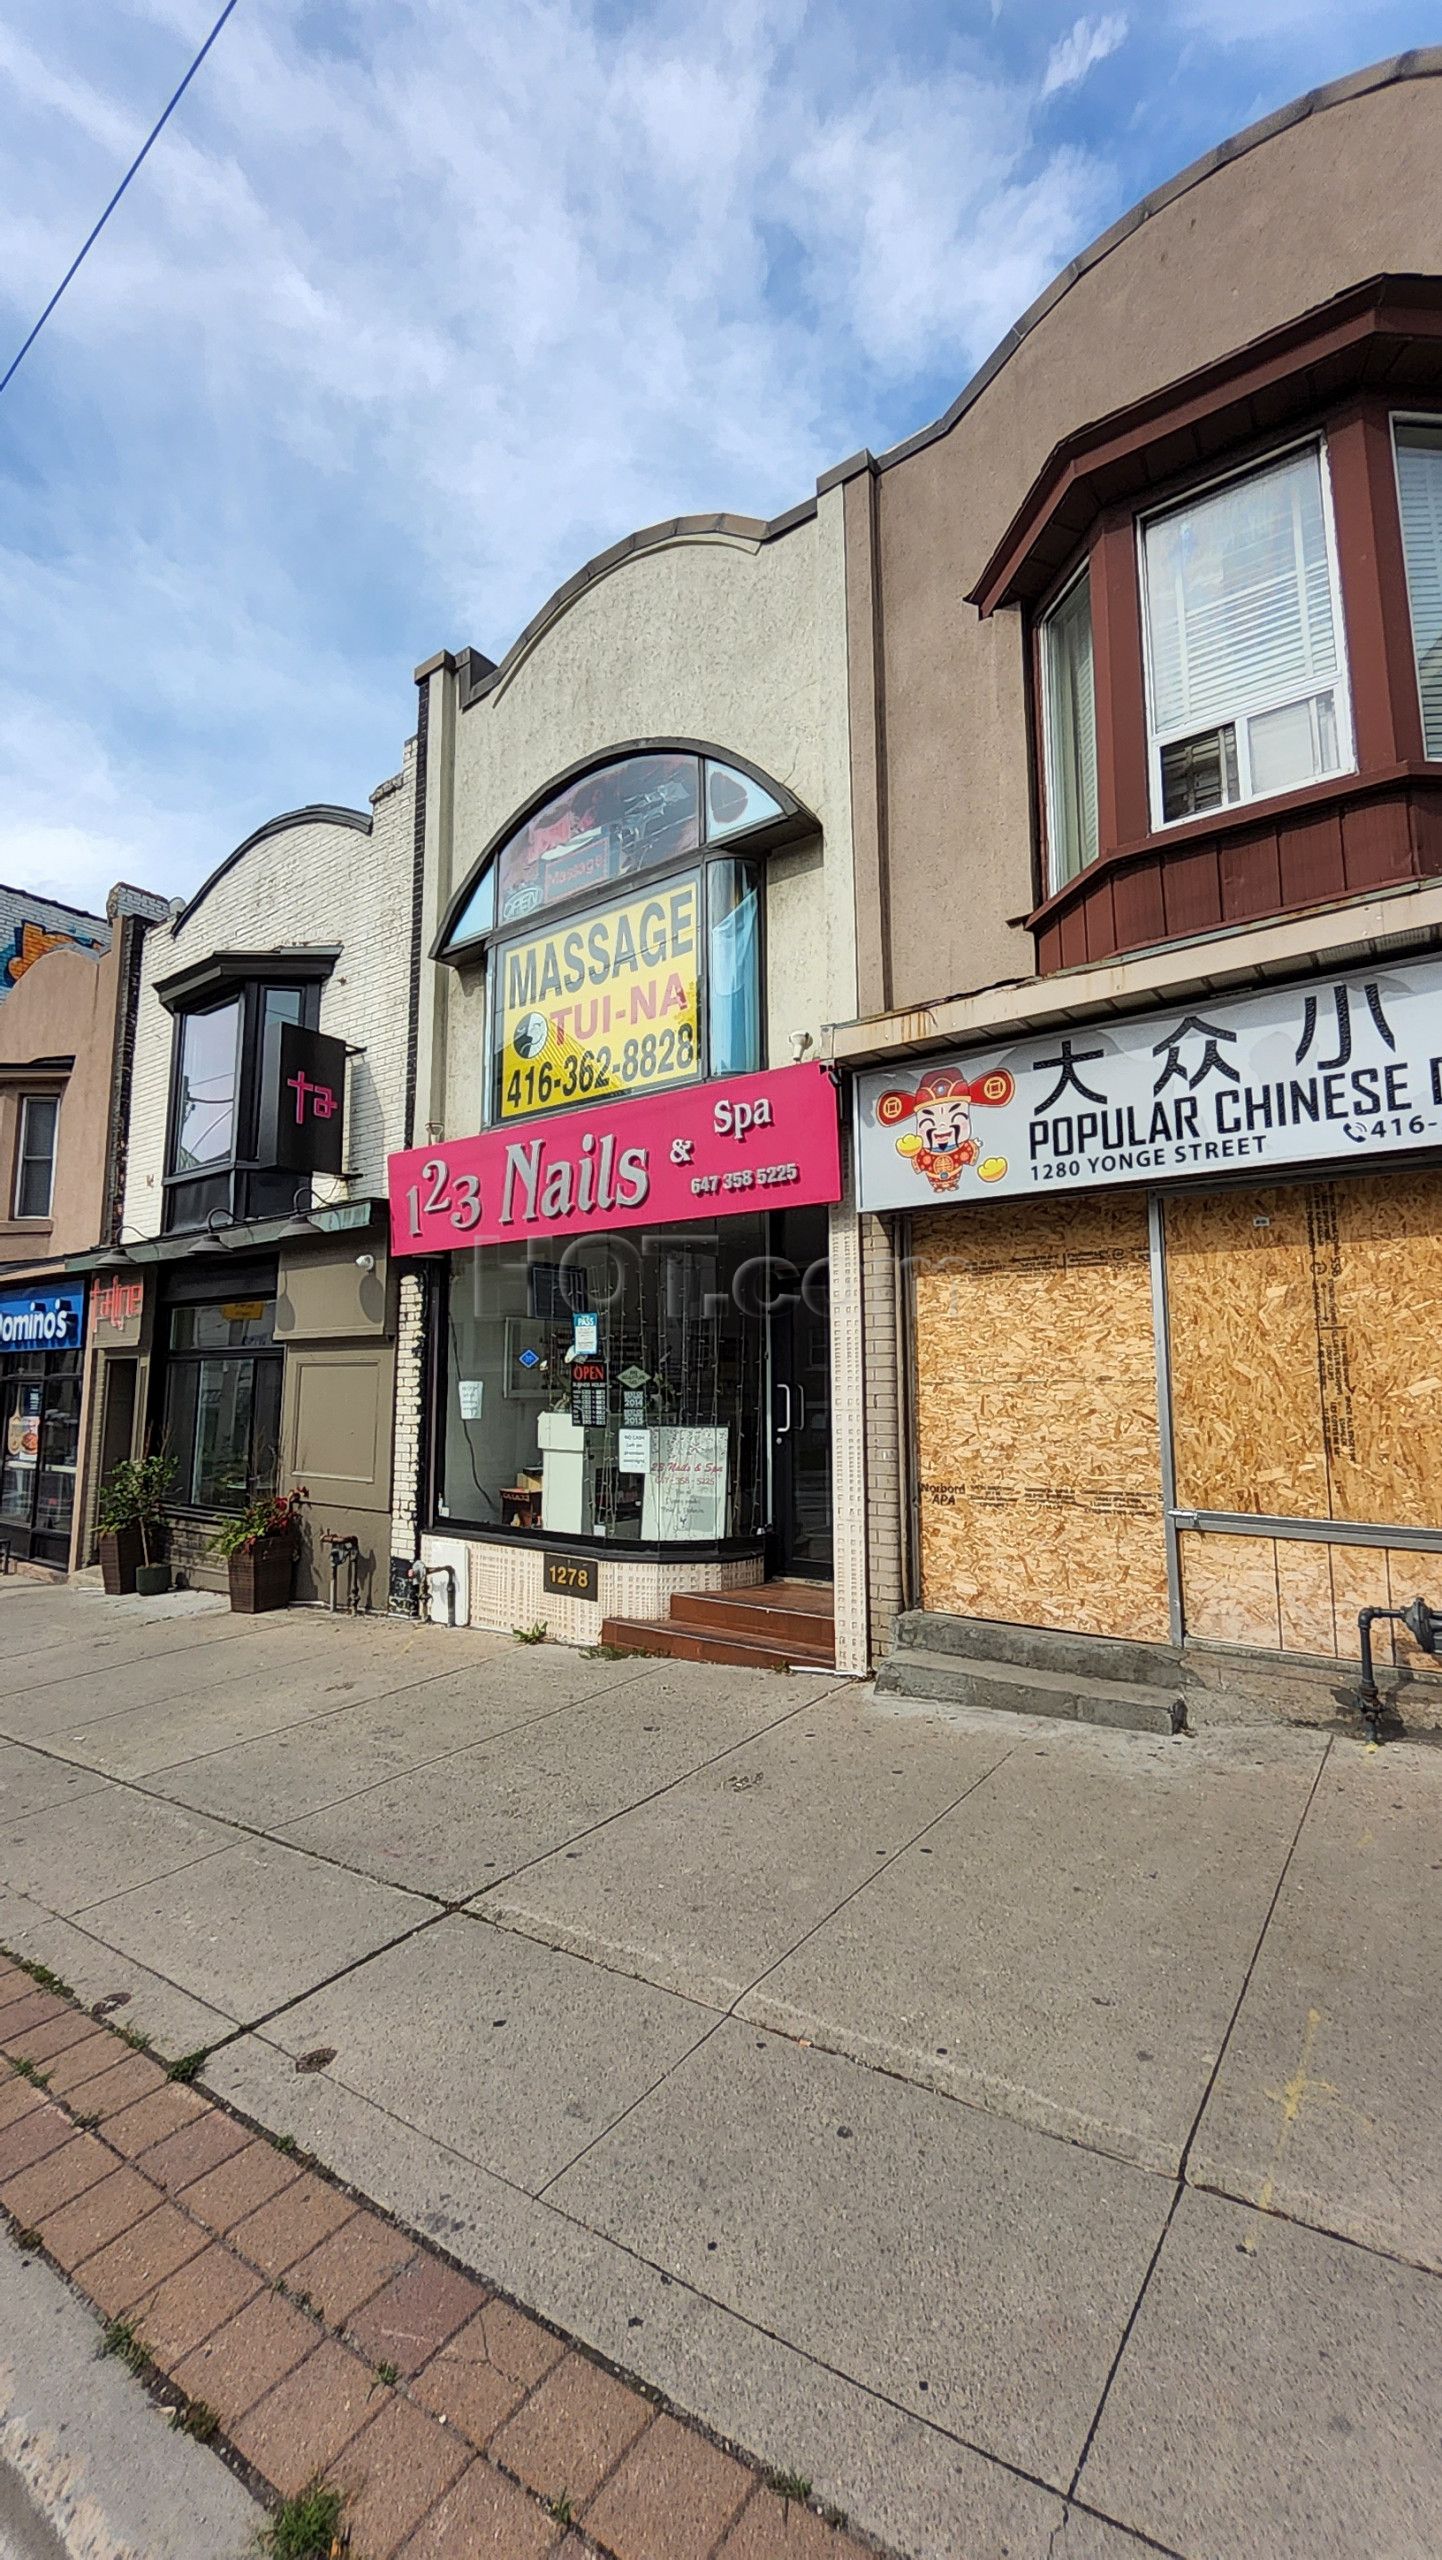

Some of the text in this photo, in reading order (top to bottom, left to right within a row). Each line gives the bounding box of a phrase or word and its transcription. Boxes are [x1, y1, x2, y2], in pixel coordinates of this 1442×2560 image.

[508, 890, 694, 1010] MASSAGE
[549, 972, 688, 1046] TUI-NA
[507, 1022, 693, 1108] 416-362-8828
[1029, 1095, 1199, 1160] POPULAR
[1216, 1063, 1412, 1135] CHINESE
[1371, 1115, 1438, 1139] 416-
[406, 1097, 772, 1236] 123 Nails & Spa
[690, 1163, 798, 1196] 647 358 5225
[1030, 1135, 1268, 1181] 1280 YONGE STREET
[0, 1298, 68, 1341] omino's
[573, 1366, 604, 1380] OPEN
[920, 1483, 966, 1494] Norbord
[932, 1494, 956, 1506] APA
[548, 1564, 589, 1588] 1278
